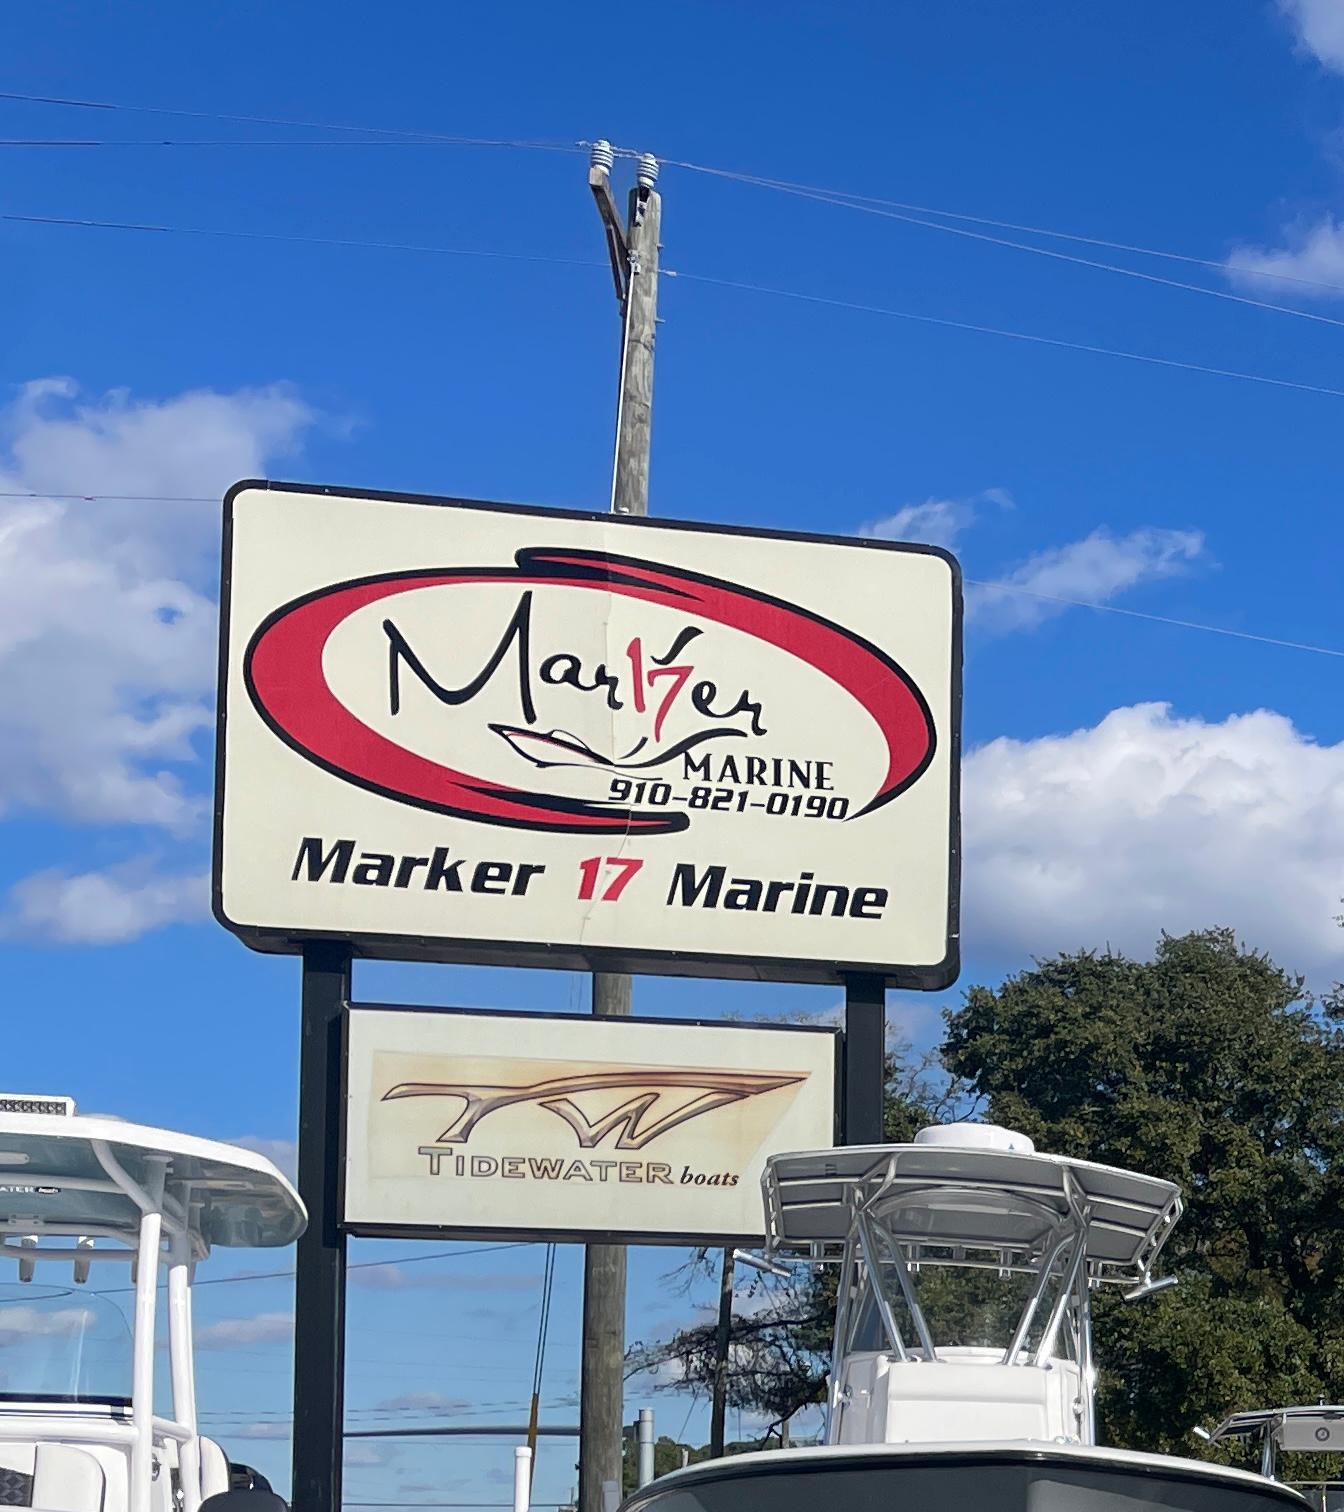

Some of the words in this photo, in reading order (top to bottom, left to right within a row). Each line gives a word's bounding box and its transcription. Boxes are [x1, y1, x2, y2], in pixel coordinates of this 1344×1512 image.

[683, 750, 834, 790] MARINE
[608, 778, 850, 820] 910-821-0190
[291, 836, 546, 896] Marker
[577, 856, 644, 902] 17
[666, 863, 889, 919] Marine
[680, 1168, 740, 1188] boats
